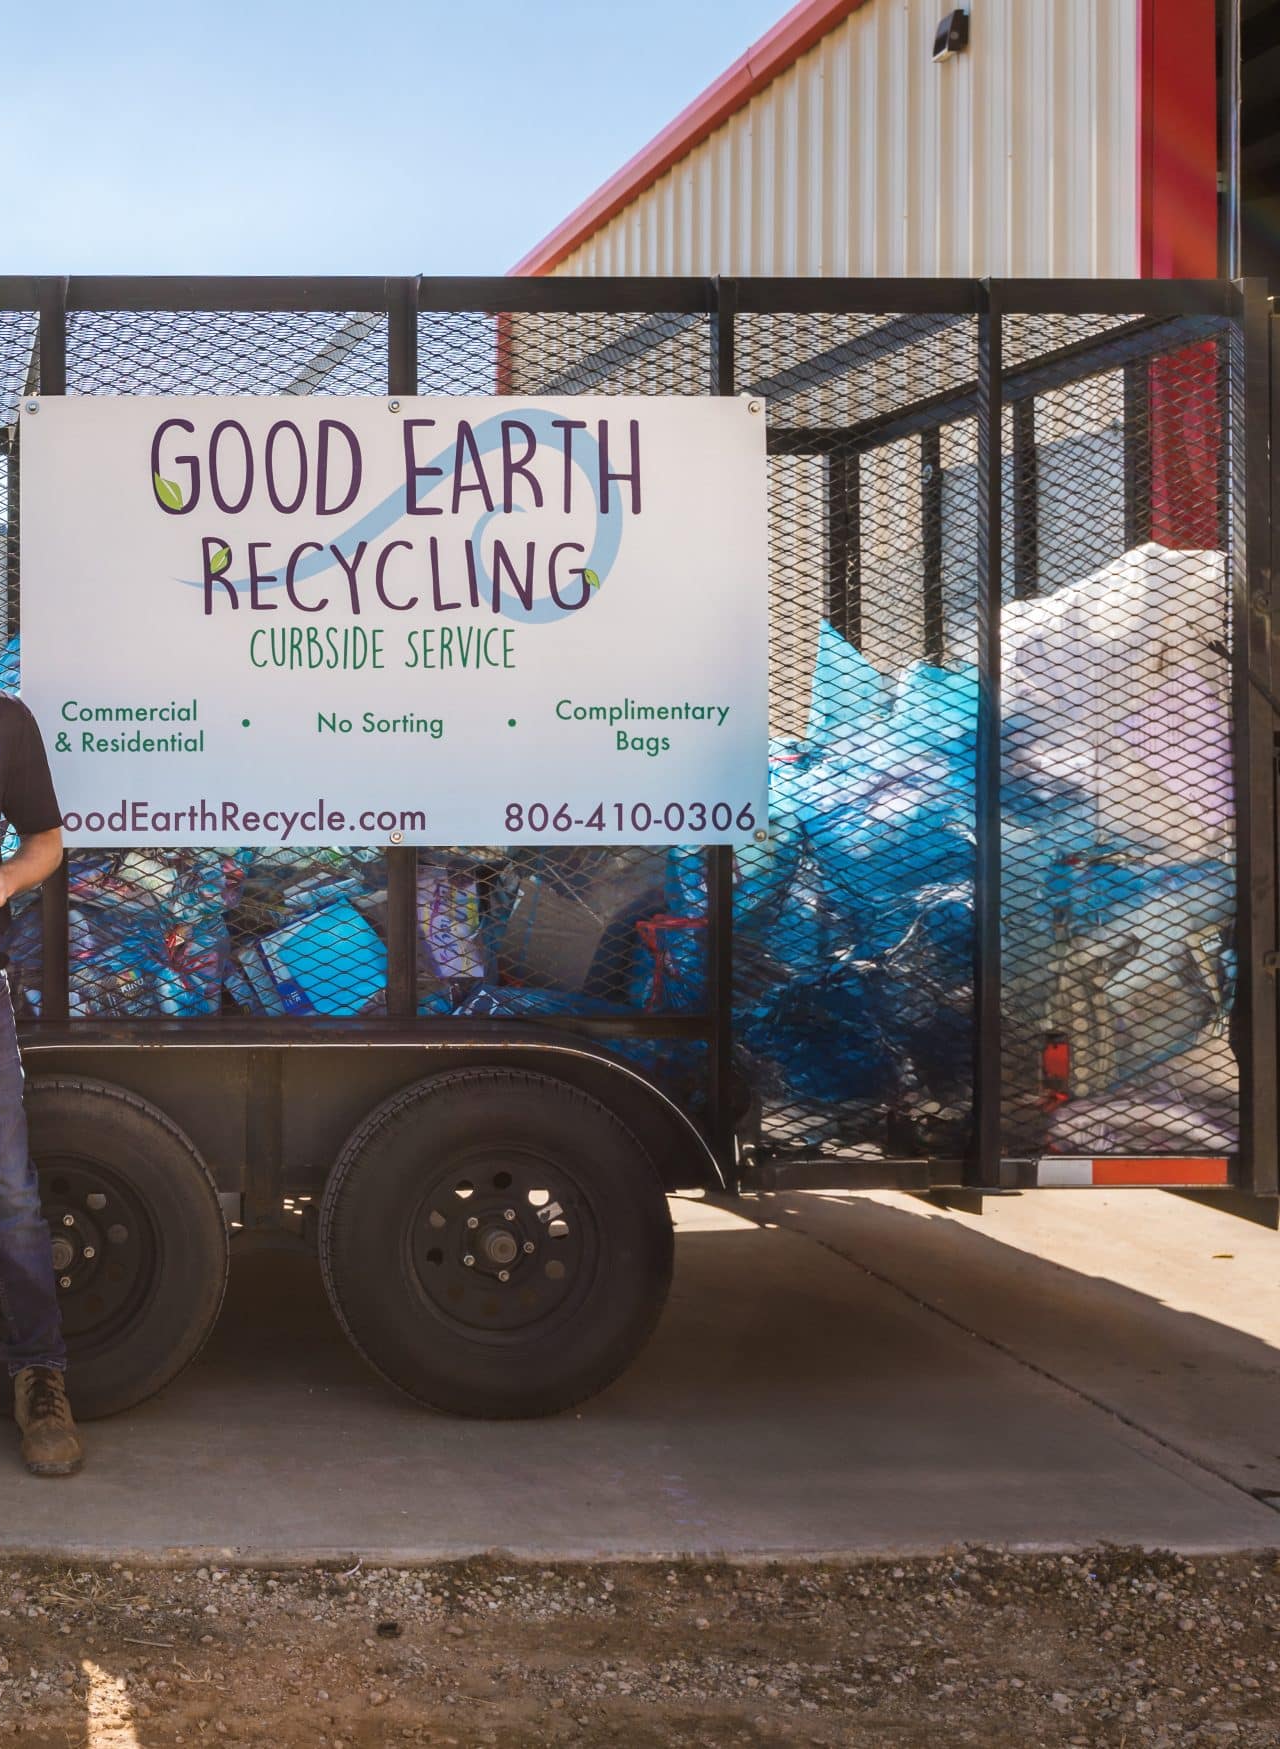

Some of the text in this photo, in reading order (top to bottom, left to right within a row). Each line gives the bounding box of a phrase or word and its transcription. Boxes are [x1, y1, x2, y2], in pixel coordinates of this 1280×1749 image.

[151, 418, 641, 516] GOOD EARTH
[202, 536, 592, 616] RECYCLING
[250, 626, 516, 670] CURBSIDE SERVICE
[61, 699, 198, 722] Commercial
[556, 699, 730, 727] Complimentary
[318, 712, 444, 739] No Sorting
[55, 730, 205, 753] & Residential
[616, 731, 670, 757] Bags
[64, 799, 756, 840] oodEarthRecycle.com 806-410-0306
